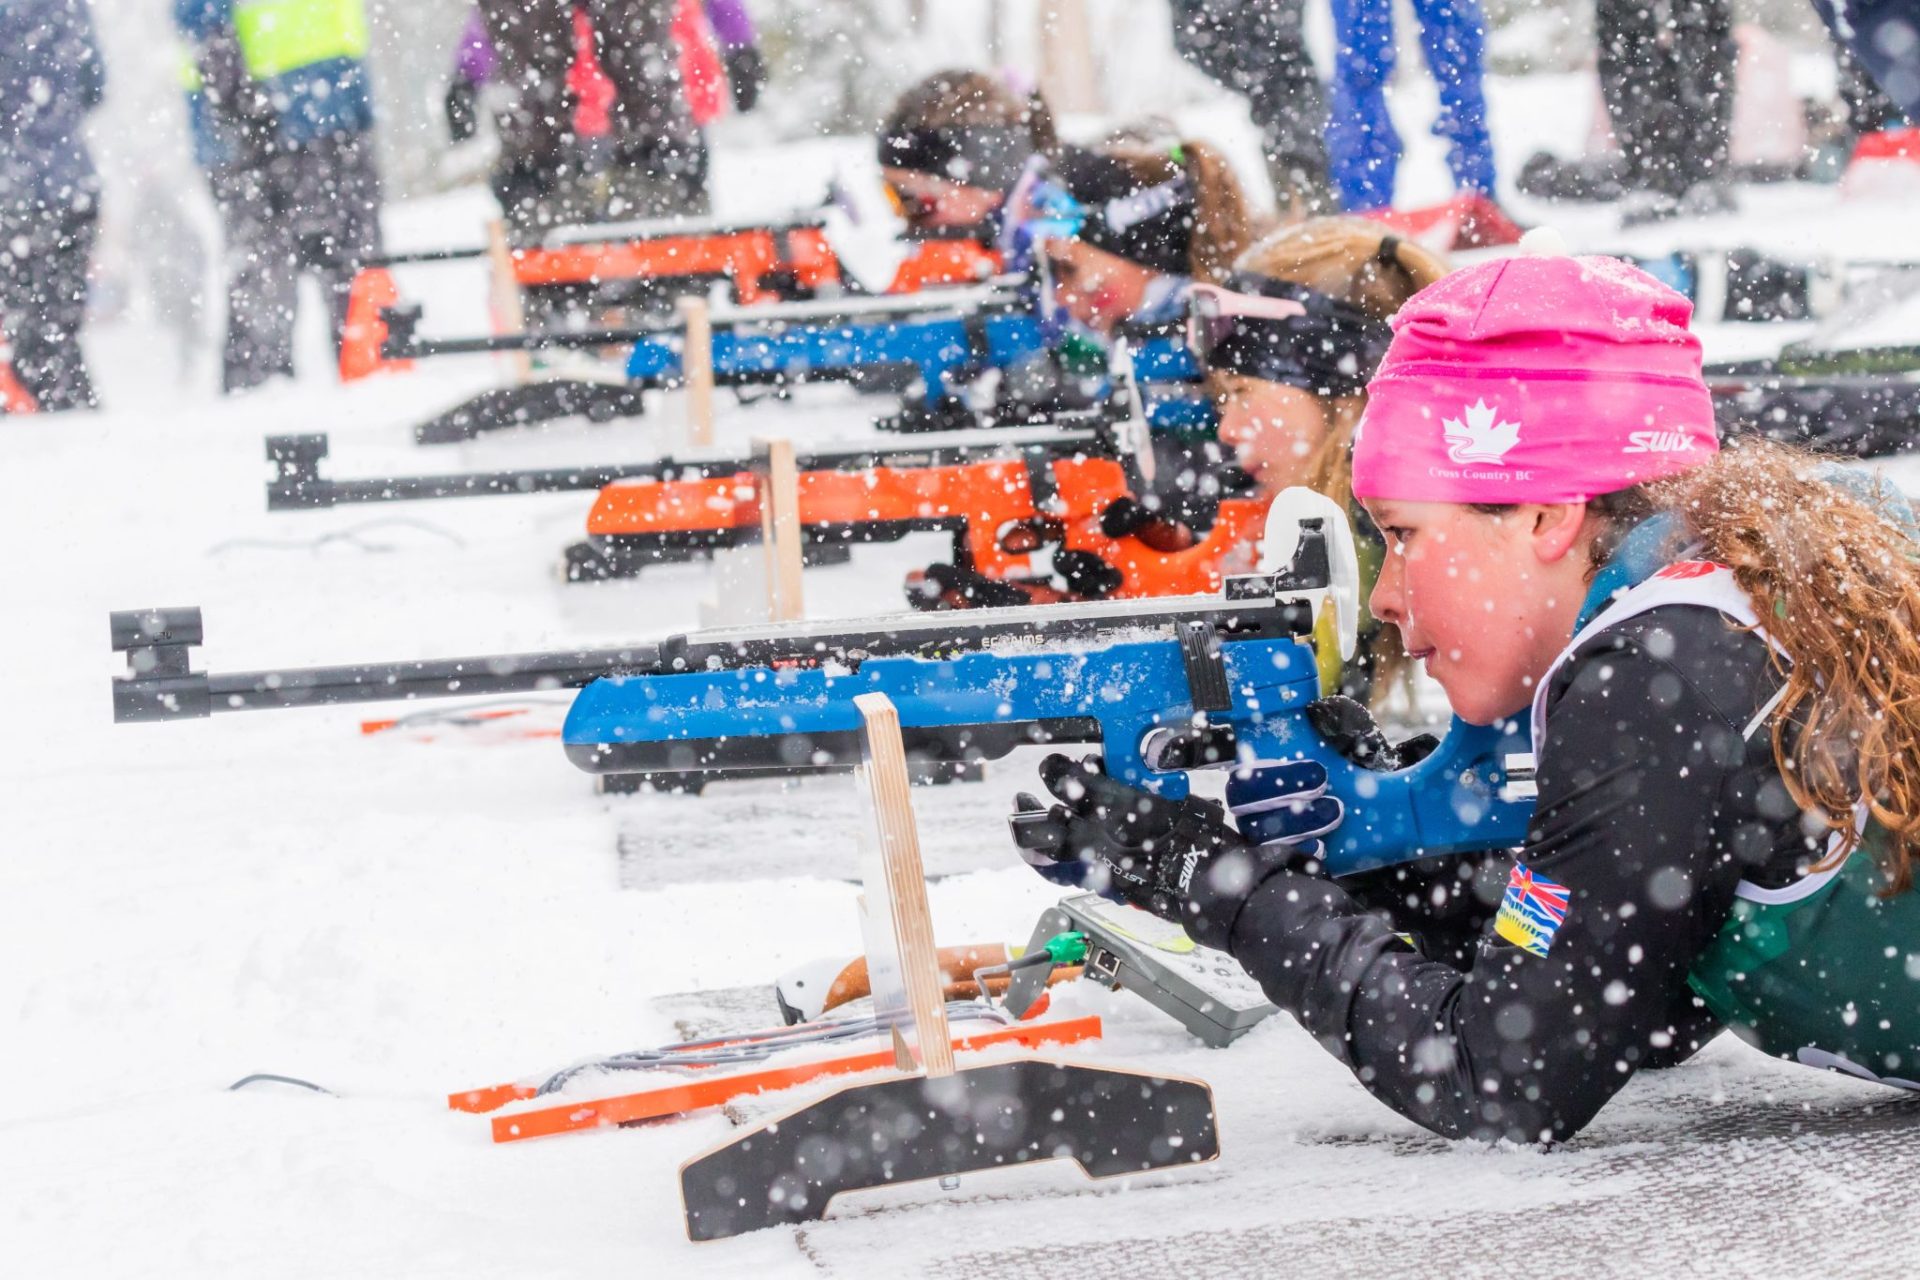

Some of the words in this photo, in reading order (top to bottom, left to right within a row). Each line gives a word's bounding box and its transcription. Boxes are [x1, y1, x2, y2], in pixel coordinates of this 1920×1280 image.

[1428, 466, 1459, 479] Cross
[1463, 468, 1510, 484] Country
[1515, 470, 1535, 481] BC
[1122, 871, 1147, 885] JUST
